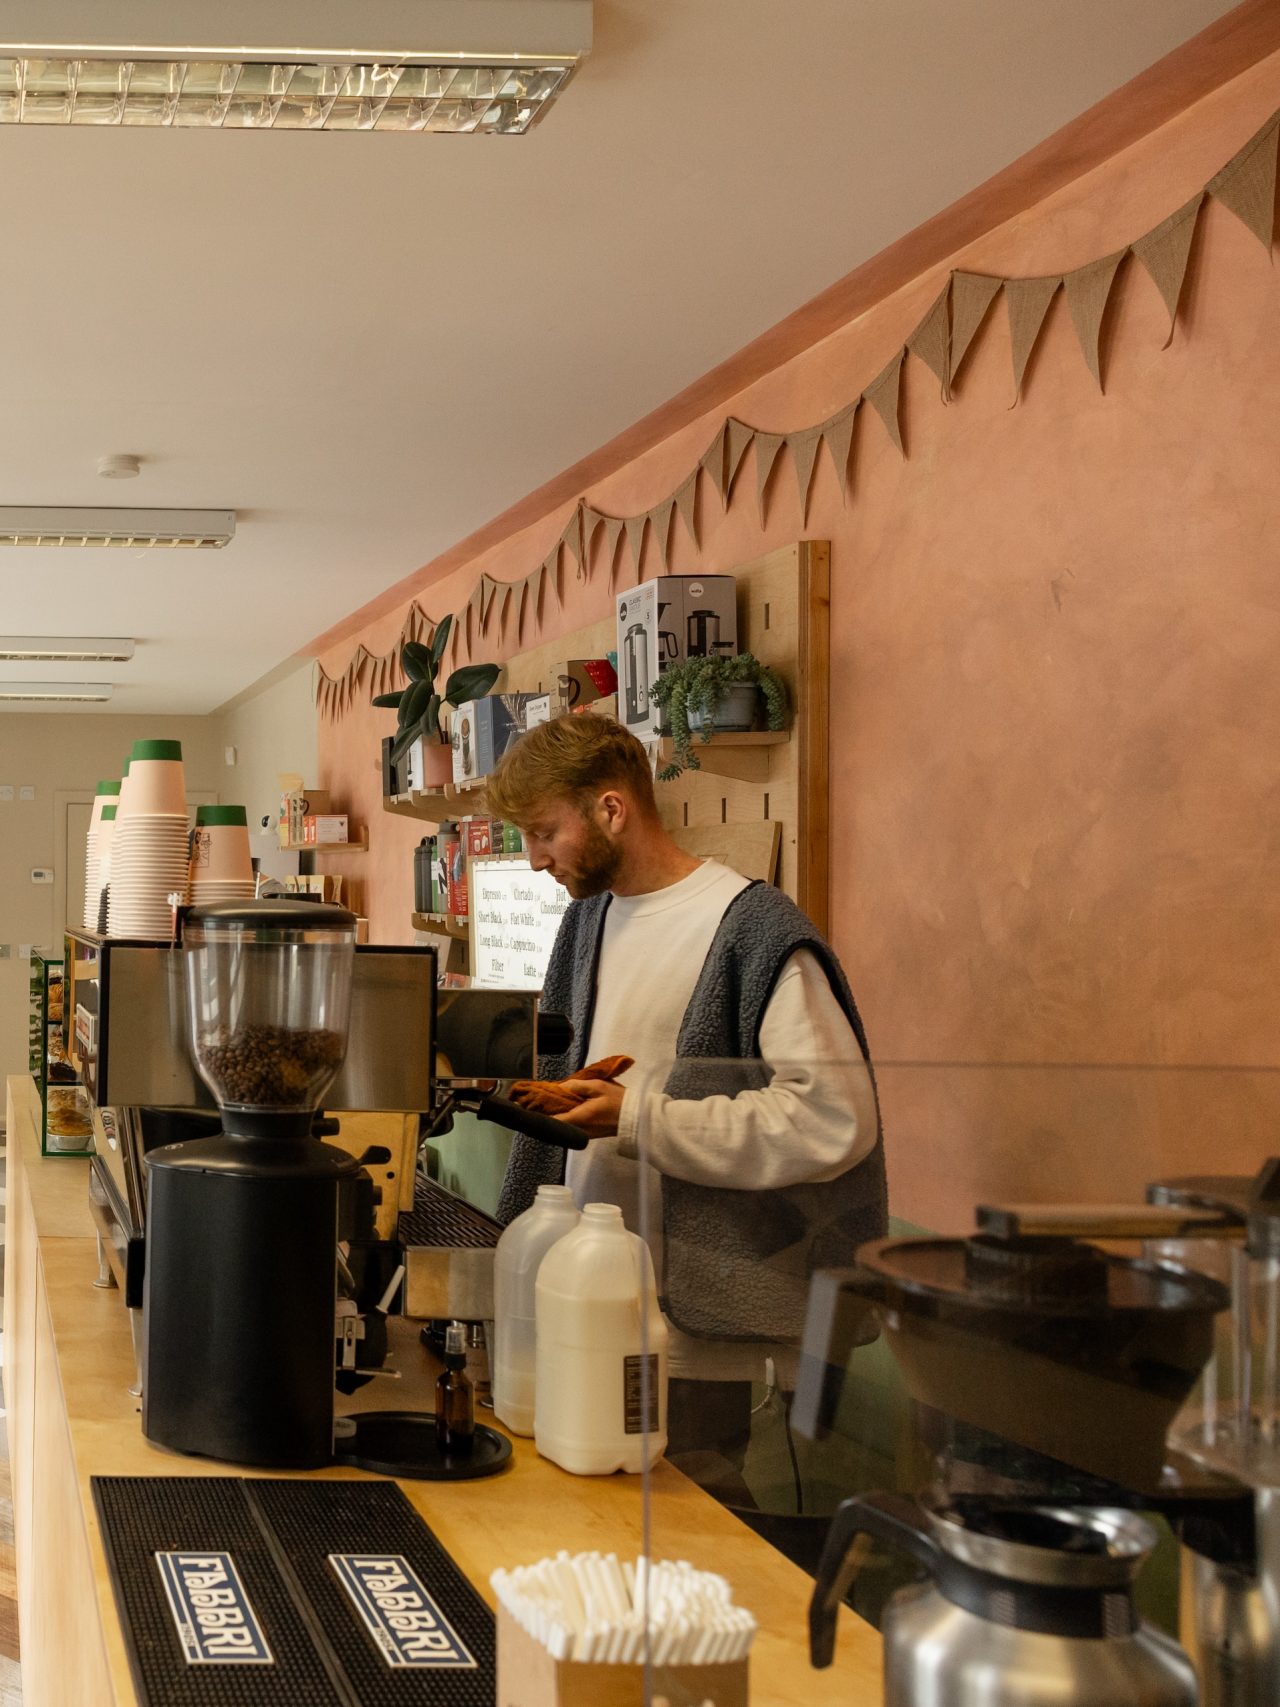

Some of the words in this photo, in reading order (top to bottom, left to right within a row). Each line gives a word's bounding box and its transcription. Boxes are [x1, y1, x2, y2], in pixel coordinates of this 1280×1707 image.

[482, 888, 501, 901] Espresso
[514, 888, 533, 900] Cortado
[556, 889, 566, 901] Hot
[478, 911, 490, 923] Short
[491, 911, 502, 924] Black
[511, 913, 520, 925] Flat
[521, 913, 535, 926] White
[480, 934, 490, 949] Long
[491, 935, 503, 948] Black
[524, 963, 537, 977] Latte
[178, 1557, 258, 1655] FABBRI
[353, 1559, 458, 1661] FABBRI
